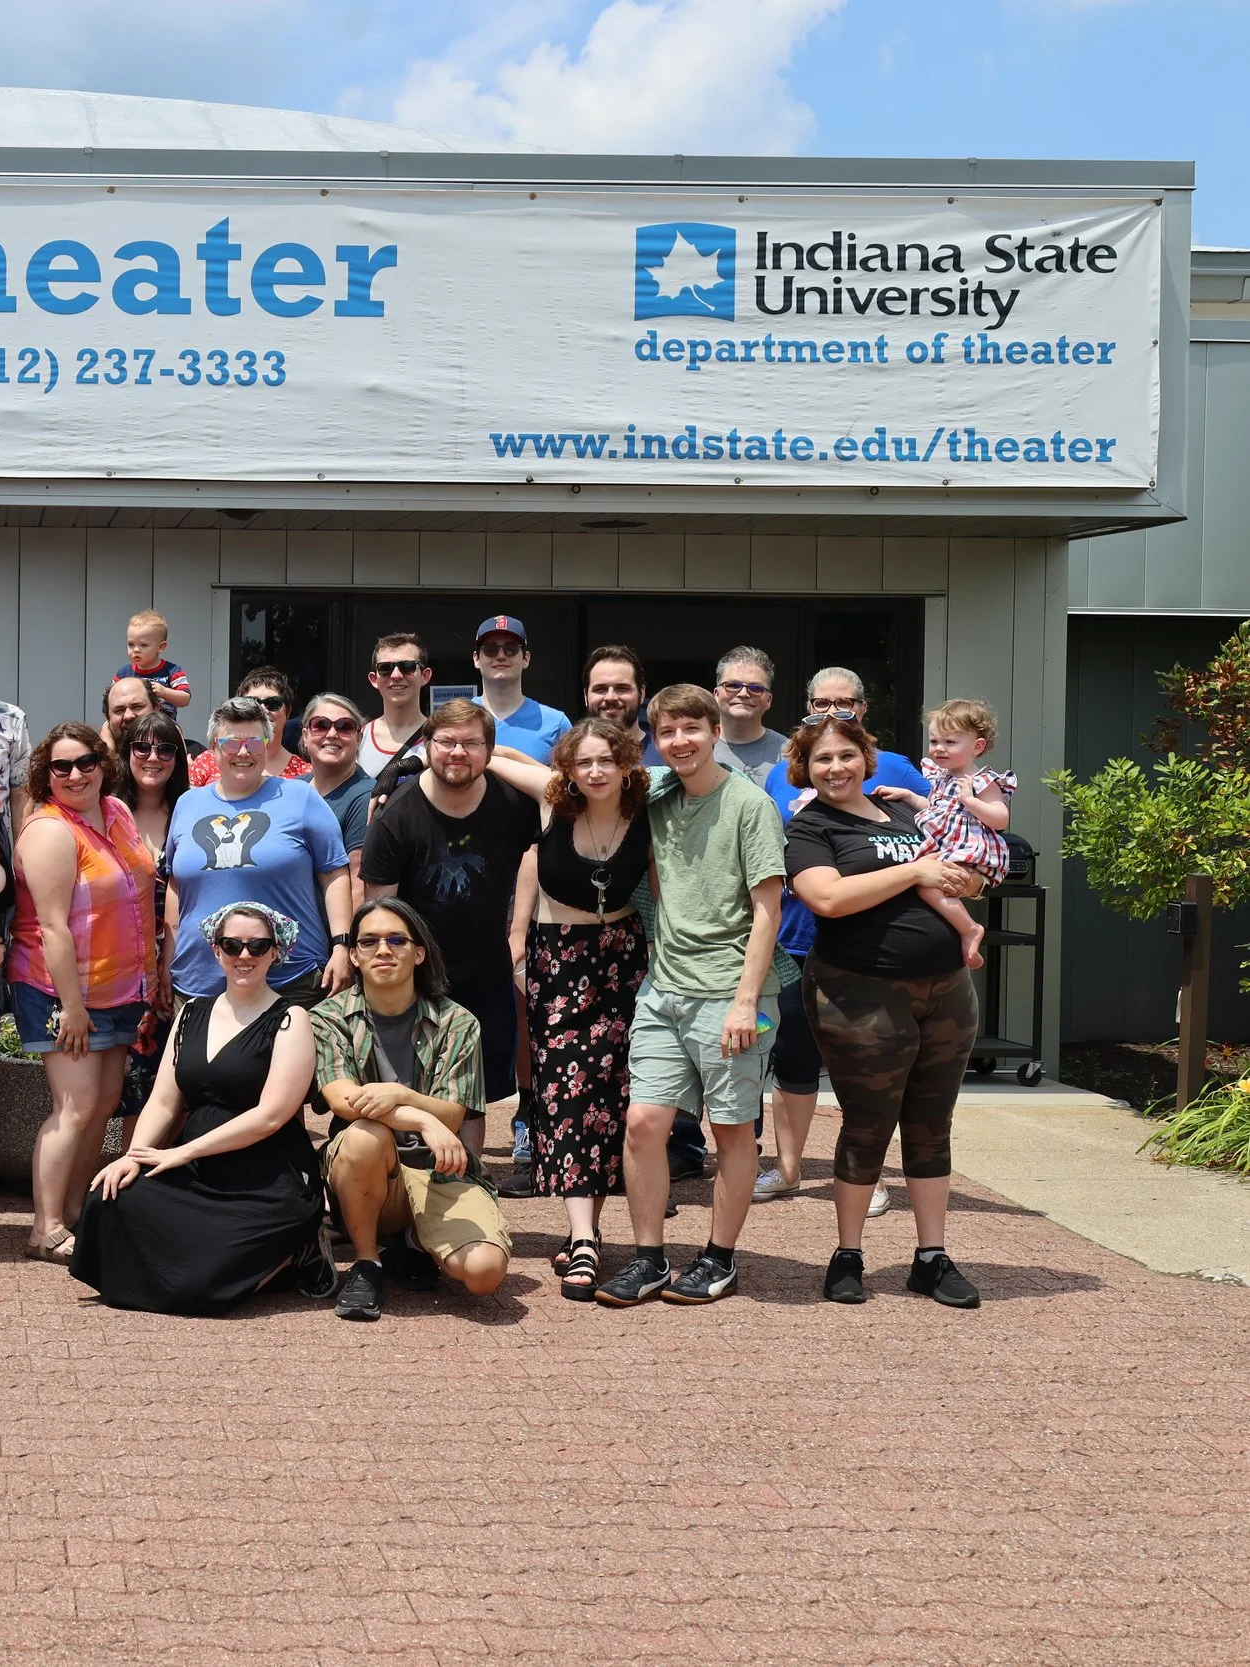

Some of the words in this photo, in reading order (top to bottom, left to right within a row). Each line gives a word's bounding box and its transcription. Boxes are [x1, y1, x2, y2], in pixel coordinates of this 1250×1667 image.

[755, 230, 966, 274] Indiana
[984, 232, 1118, 274] State
[754, 275, 1020, 330] University
[75, 347, 287, 387] 237-3333
[634, 329, 889, 371] department
[905, 332, 949, 364] of
[962, 332, 1117, 365] theater
[488, 423, 1117, 463] www.indstate.edu/theater
